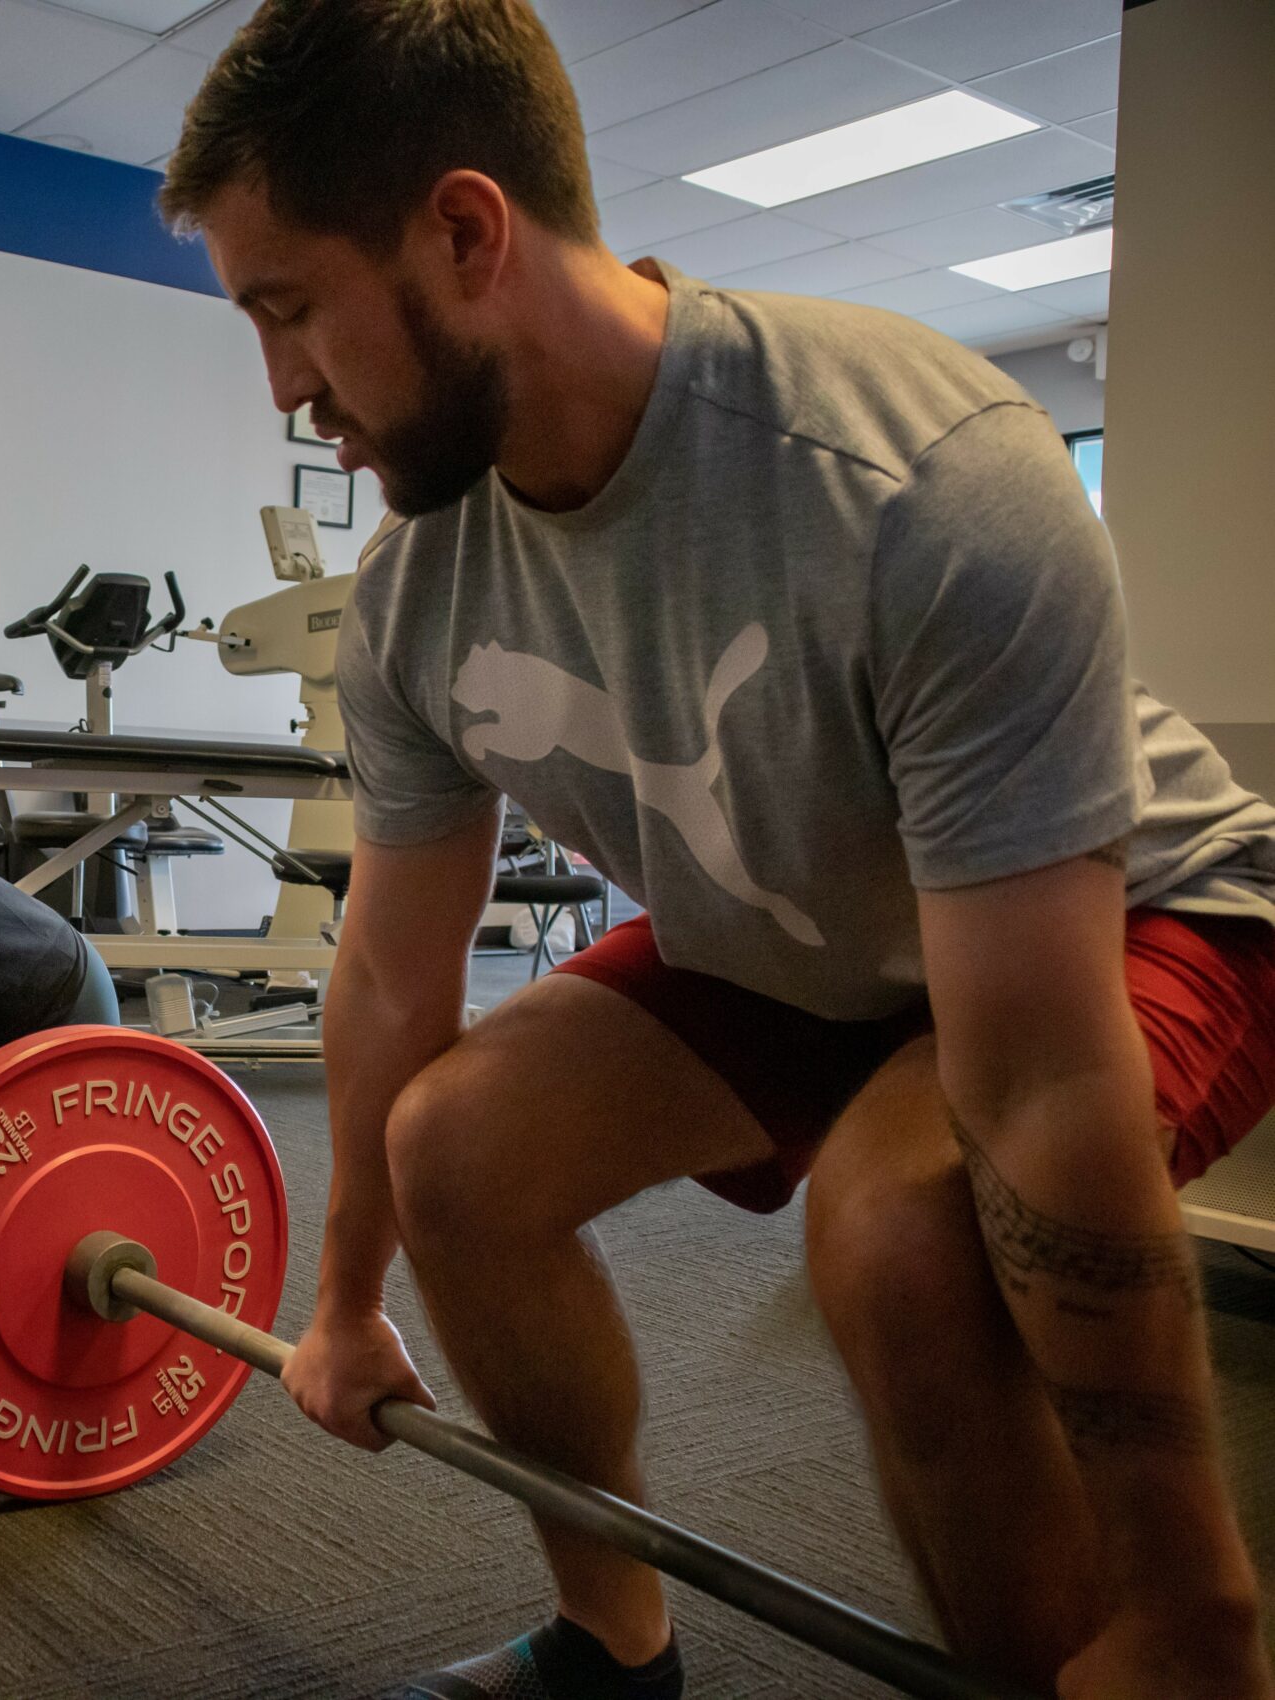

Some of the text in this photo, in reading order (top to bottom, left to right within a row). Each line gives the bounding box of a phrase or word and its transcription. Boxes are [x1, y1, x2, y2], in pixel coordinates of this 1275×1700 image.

[15, 1111, 37, 1139] LB
[52, 1079, 253, 1354] FRINGE SPOR
[156, 1368, 190, 1416] TRAINING
[167, 1355, 206, 1400] 25
[151, 1389, 174, 1415] LB
